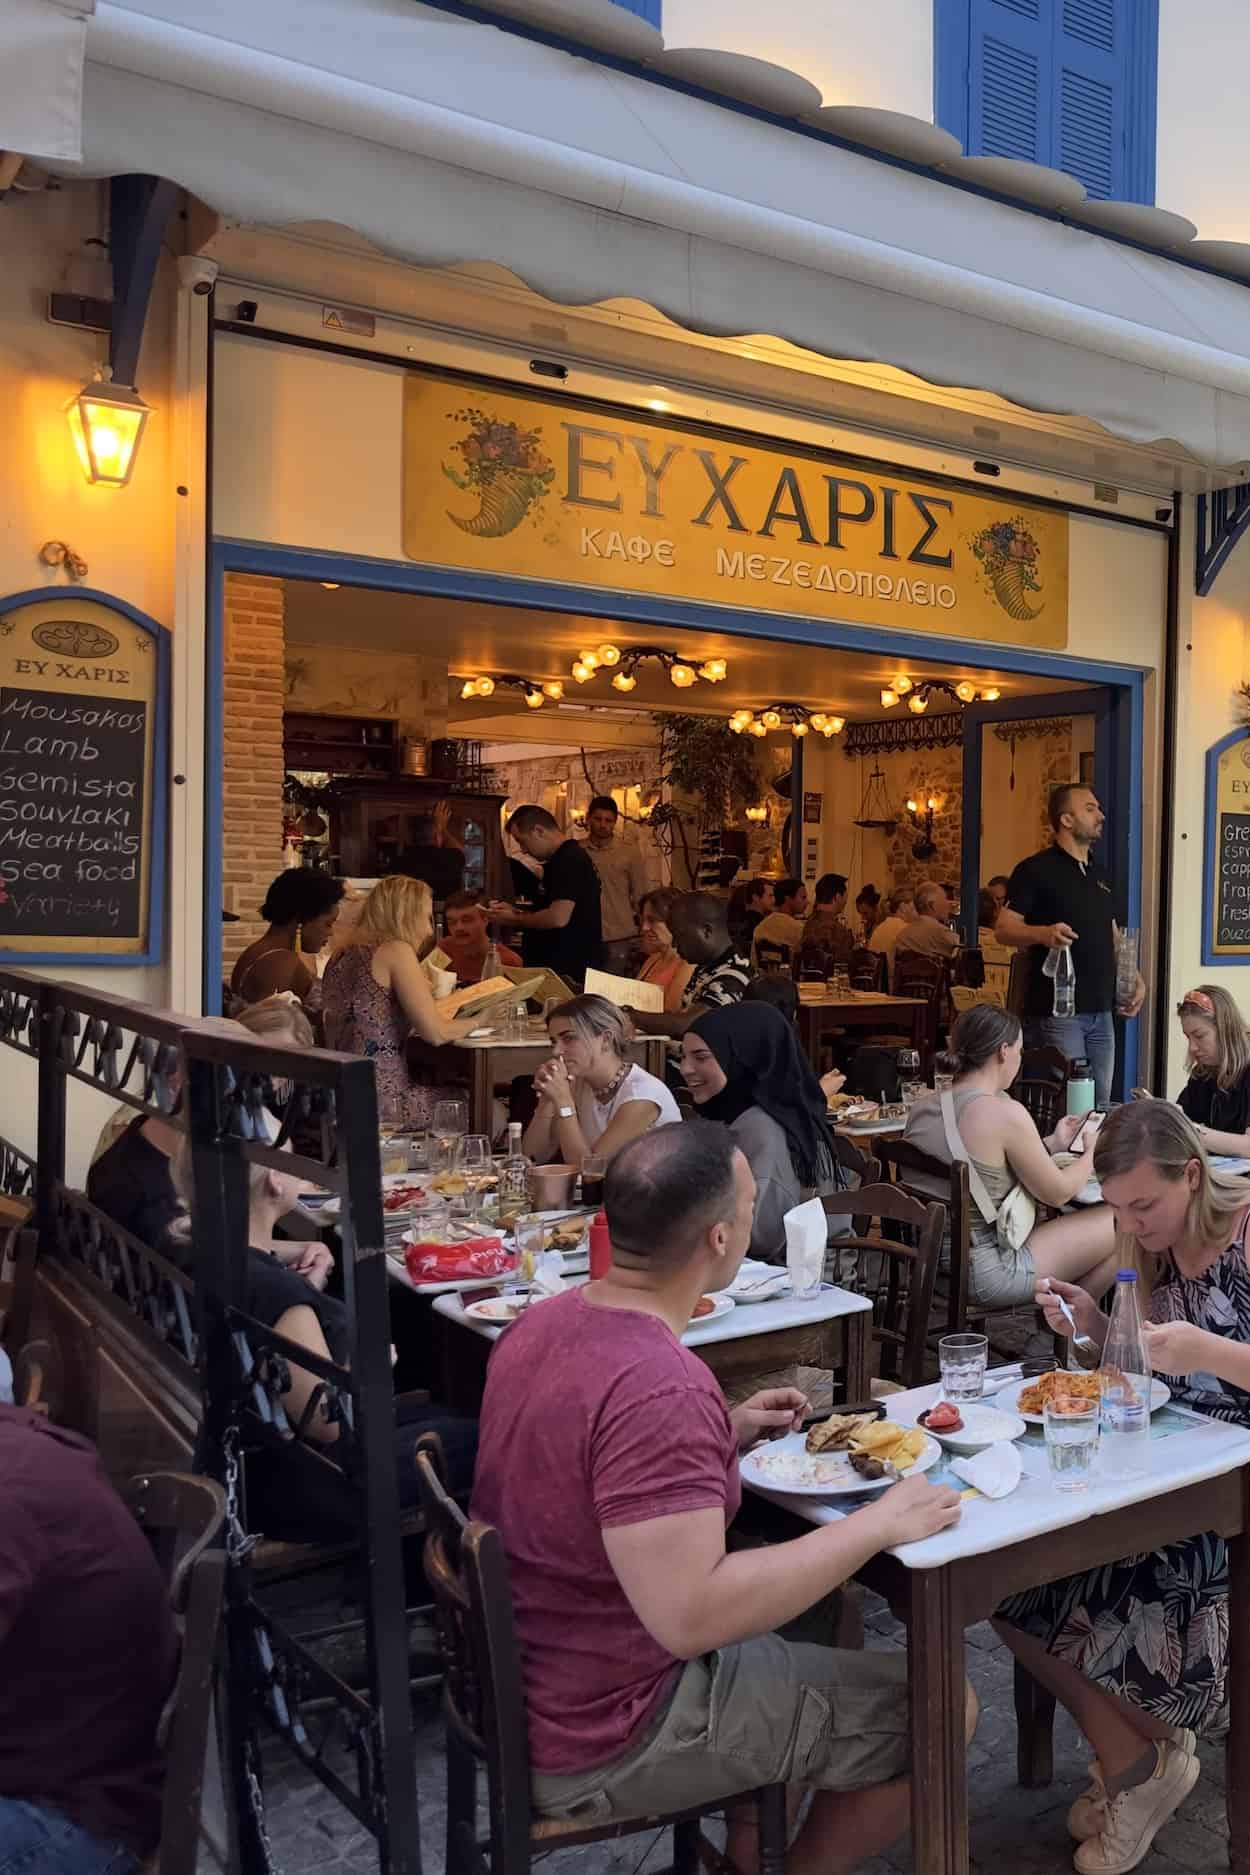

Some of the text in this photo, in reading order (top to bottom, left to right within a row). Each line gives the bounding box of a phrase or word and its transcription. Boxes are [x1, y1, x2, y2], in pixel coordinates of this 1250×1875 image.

[580, 527, 957, 609] ΚΑΦΕ ΜΕΖΕΔΟΠΩΛΕΙΟ
[55, 663, 129, 684] ΧΑΡΙΣ
[0, 729, 99, 760] Lamb
[0, 767, 136, 797] Gemista
[0, 858, 136, 882] Sea food
